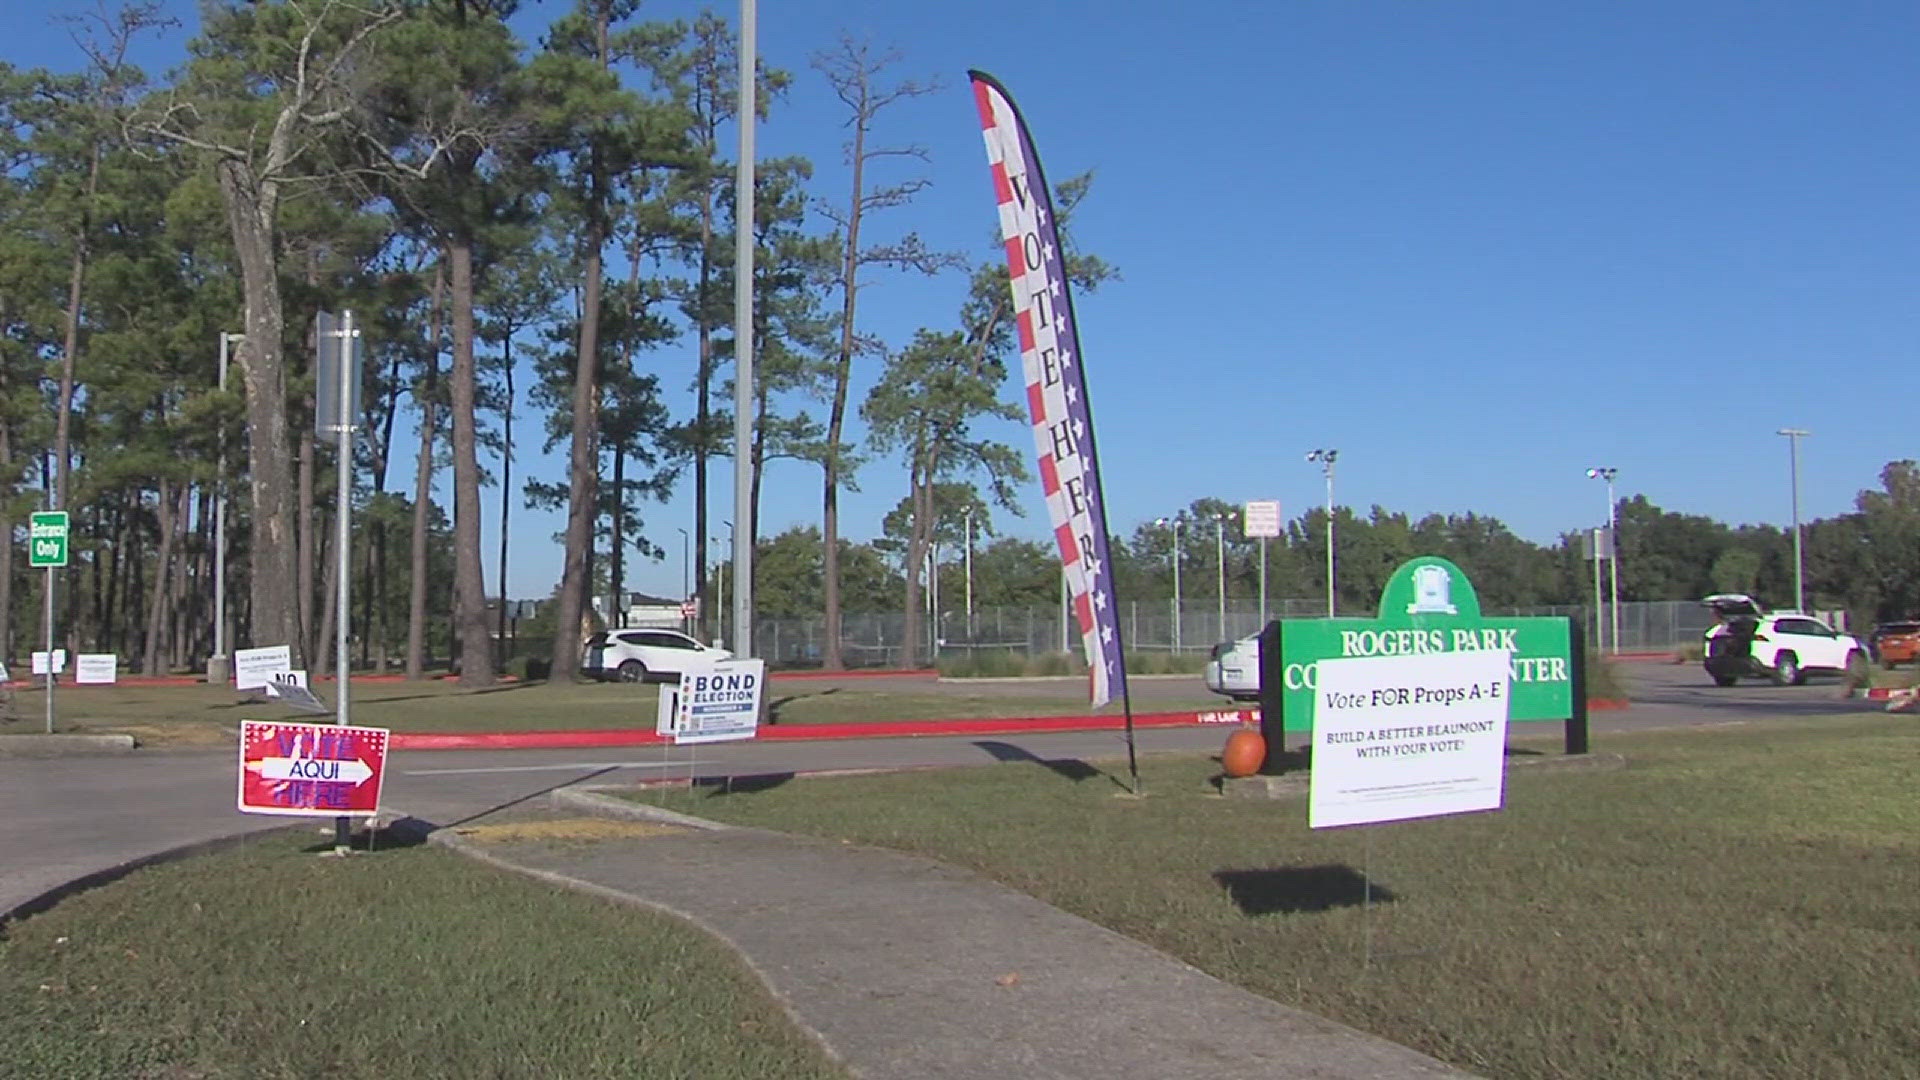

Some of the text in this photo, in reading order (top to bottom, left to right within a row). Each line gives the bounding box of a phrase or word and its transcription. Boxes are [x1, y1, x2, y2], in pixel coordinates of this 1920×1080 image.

[1010, 174, 1096, 573] VOTE HER
[36, 540, 60, 559] Only
[1341, 629, 1518, 656] ROGERS PARK
[1509, 657, 1567, 682] NTER
[696, 674, 755, 691] BOND
[694, 690, 754, 703] ELECTION
[1326, 692, 1366, 709] Vote
[1371, 688, 1410, 707] FOR
[1414, 687, 1465, 706] Props
[1326, 720, 1494, 744] BUILD A BETTER BEAUMONT
[1356, 746, 1390, 758] WITH
[1393, 743, 1427, 755] YOUR
[289, 760, 339, 780] AQUI
